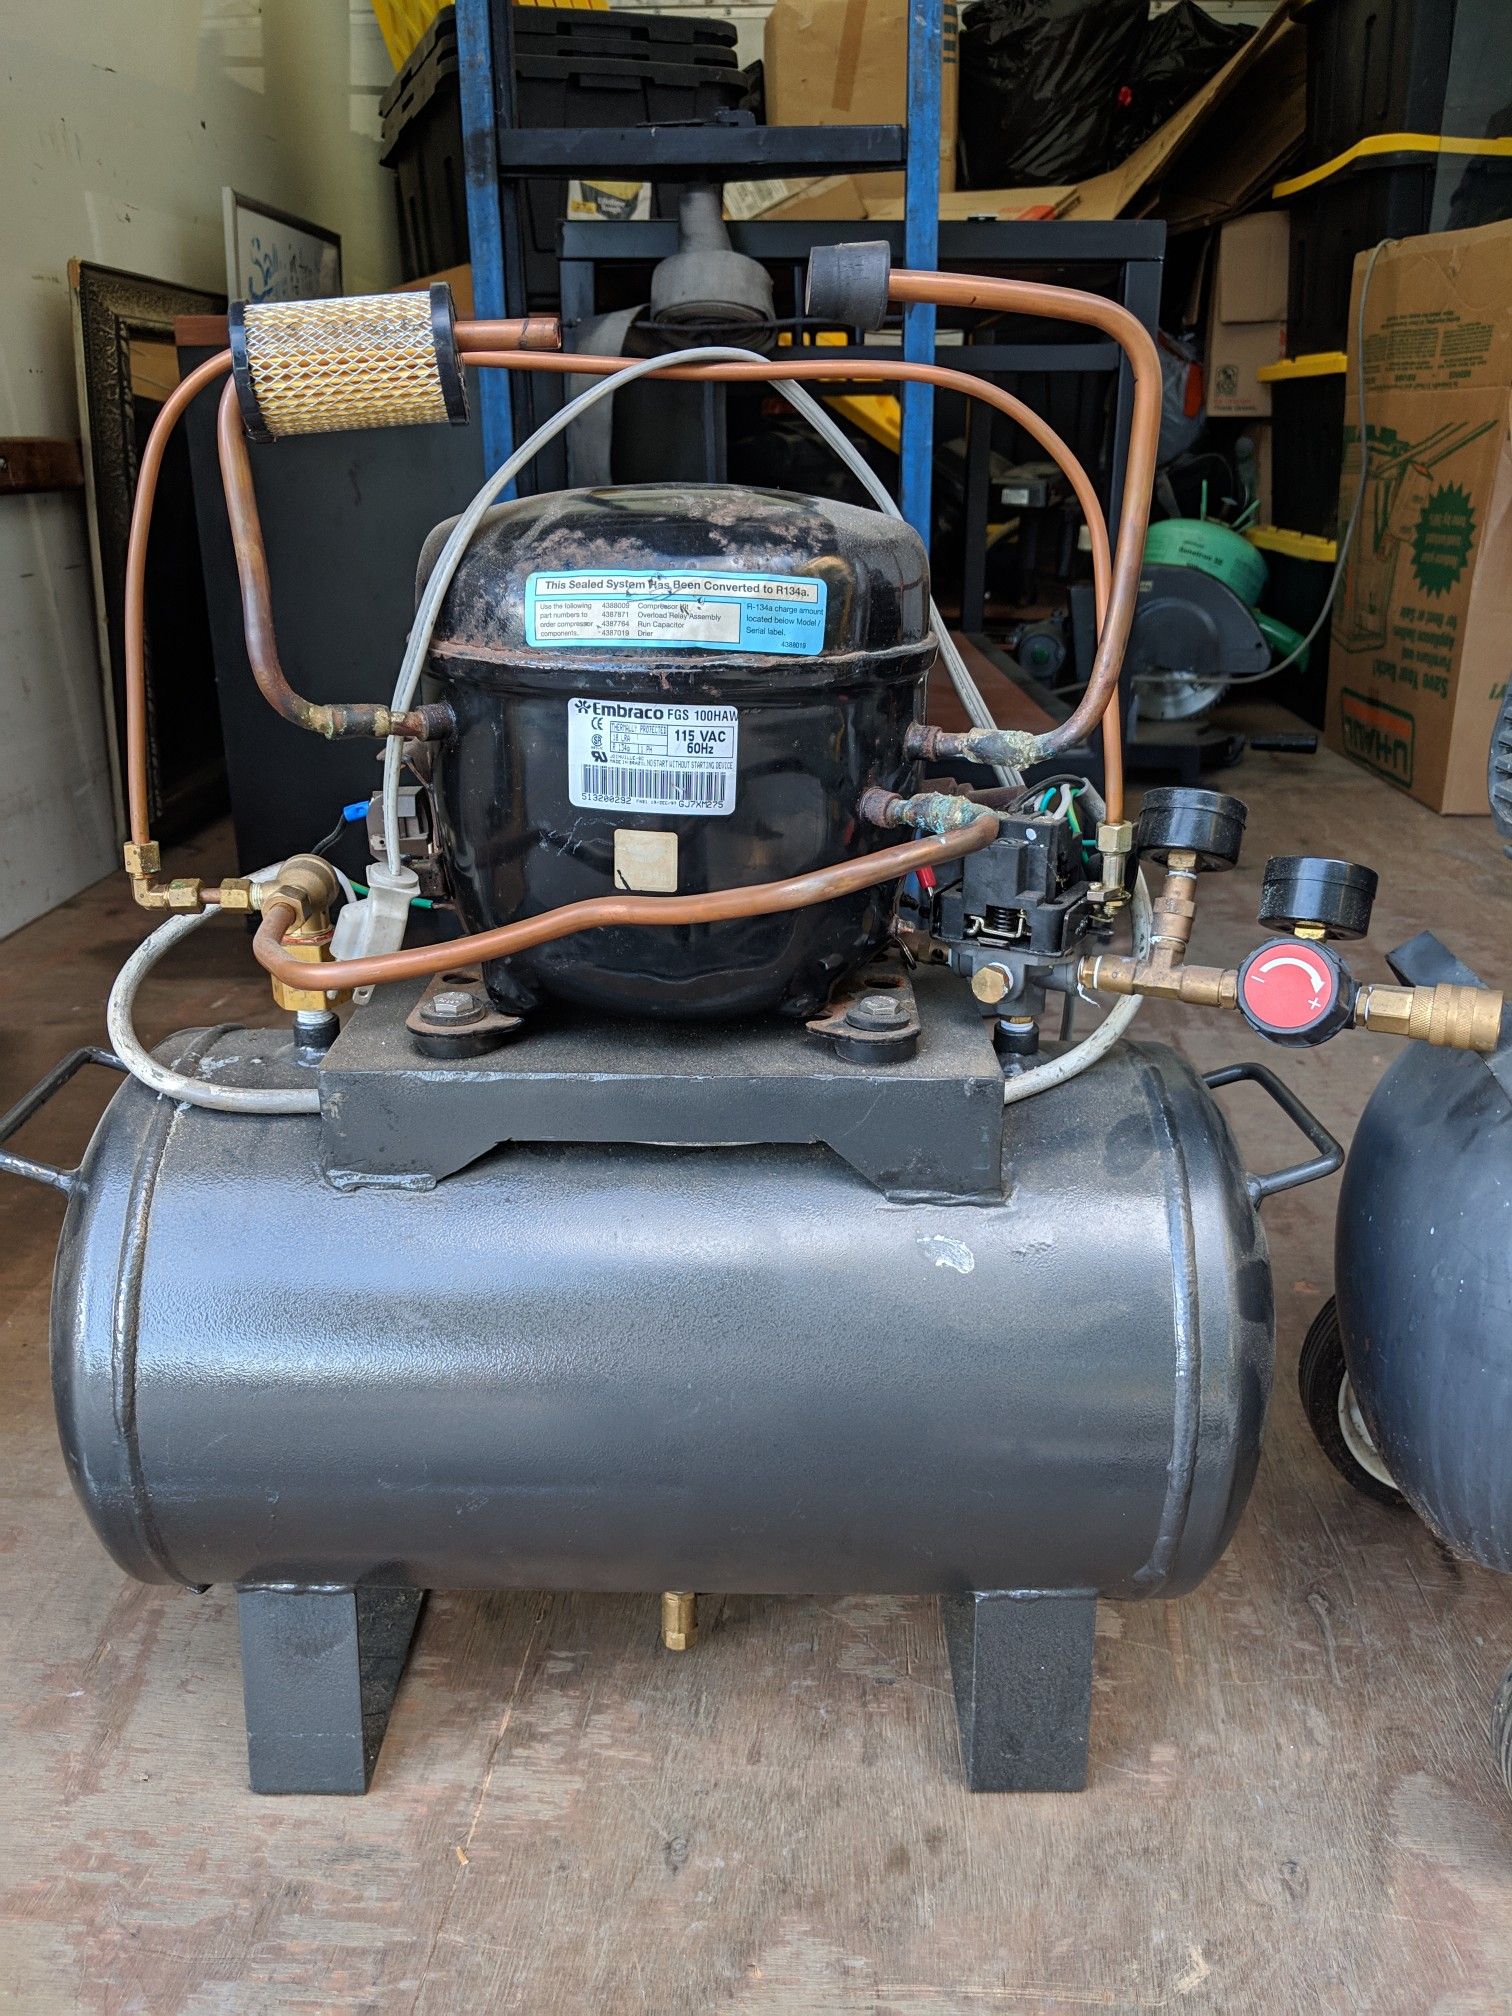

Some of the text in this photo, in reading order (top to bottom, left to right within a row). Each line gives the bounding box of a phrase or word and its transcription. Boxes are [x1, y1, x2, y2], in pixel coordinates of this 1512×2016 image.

[545, 579, 810, 597] This Sealed System Has Been Converted to R134a.
[564, 602, 592, 611] following
[637, 602, 678, 611] Compressor
[746, 603, 824, 616] R-134a charge amount
[637, 611, 722, 621] Overload Relay Assembly
[746, 615, 773, 624] located
[774, 616, 795, 625] below
[796, 618, 817, 627] Model
[652, 621, 685, 629] Capacitor
[601, 629, 630, 637] 4387019
[746, 626, 786, 636] Serial label.
[592, 701, 739, 722] Embraco FGS 100HAW
[611, 722, 667, 735] THERMALLY PROTECTED
[621, 734, 631, 742] LRA
[675, 729, 726, 743] 115 VAC
[686, 742, 714, 755] 60Hz
[655, 760, 668, 768] START
[669, 760, 690, 769] WITHOUT
[690, 761, 714, 770] STARTING
[715, 762, 733, 770] DEVICE
